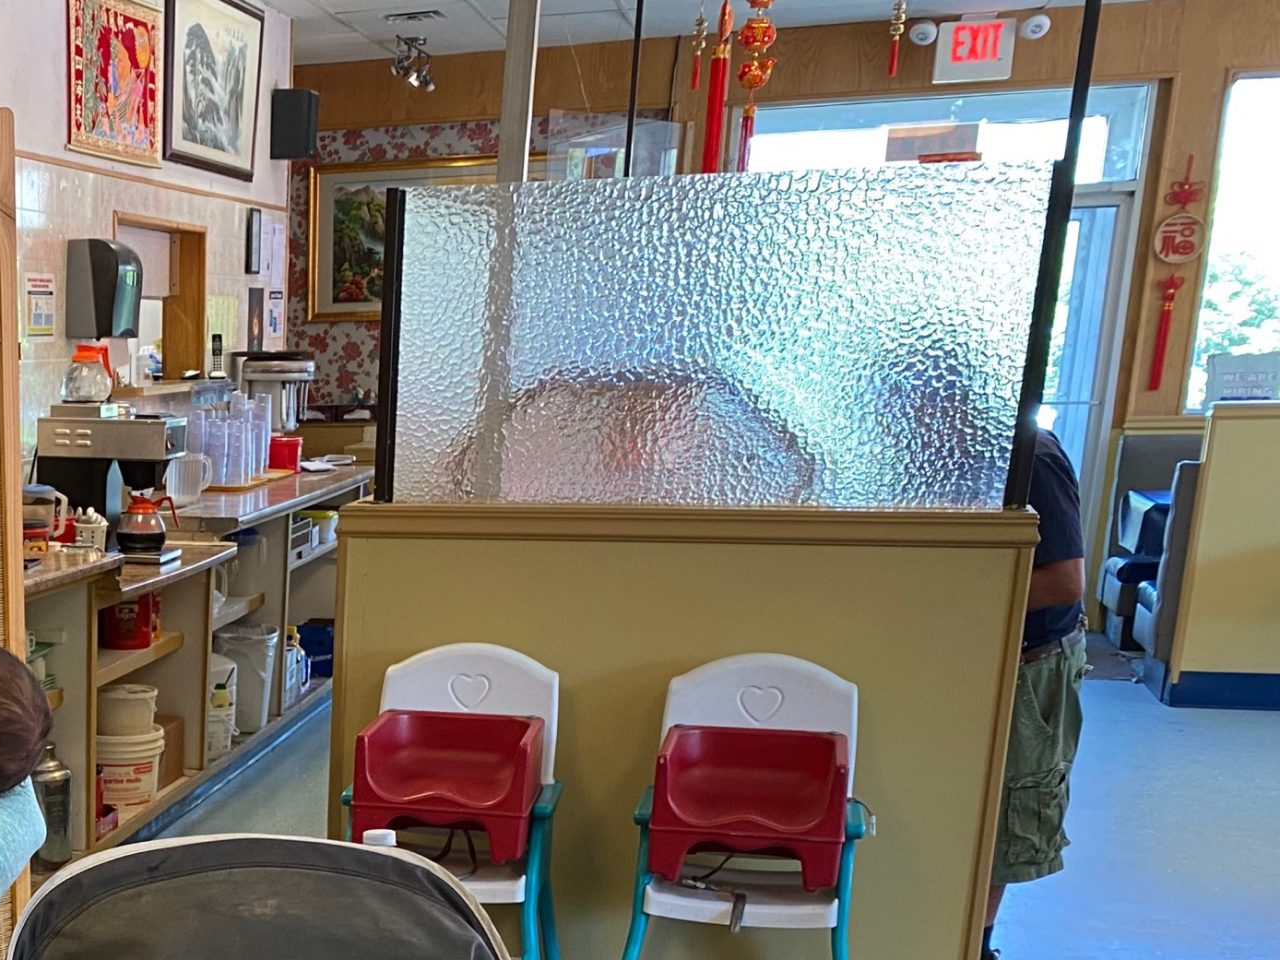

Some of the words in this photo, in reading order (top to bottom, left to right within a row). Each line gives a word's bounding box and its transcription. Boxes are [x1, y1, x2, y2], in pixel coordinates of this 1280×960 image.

[950, 21, 1005, 62] EXIT
[1222, 372, 1244, 383] WE
[1247, 372, 1277, 383] ARE
[1223, 386, 1273, 397] HIRING
